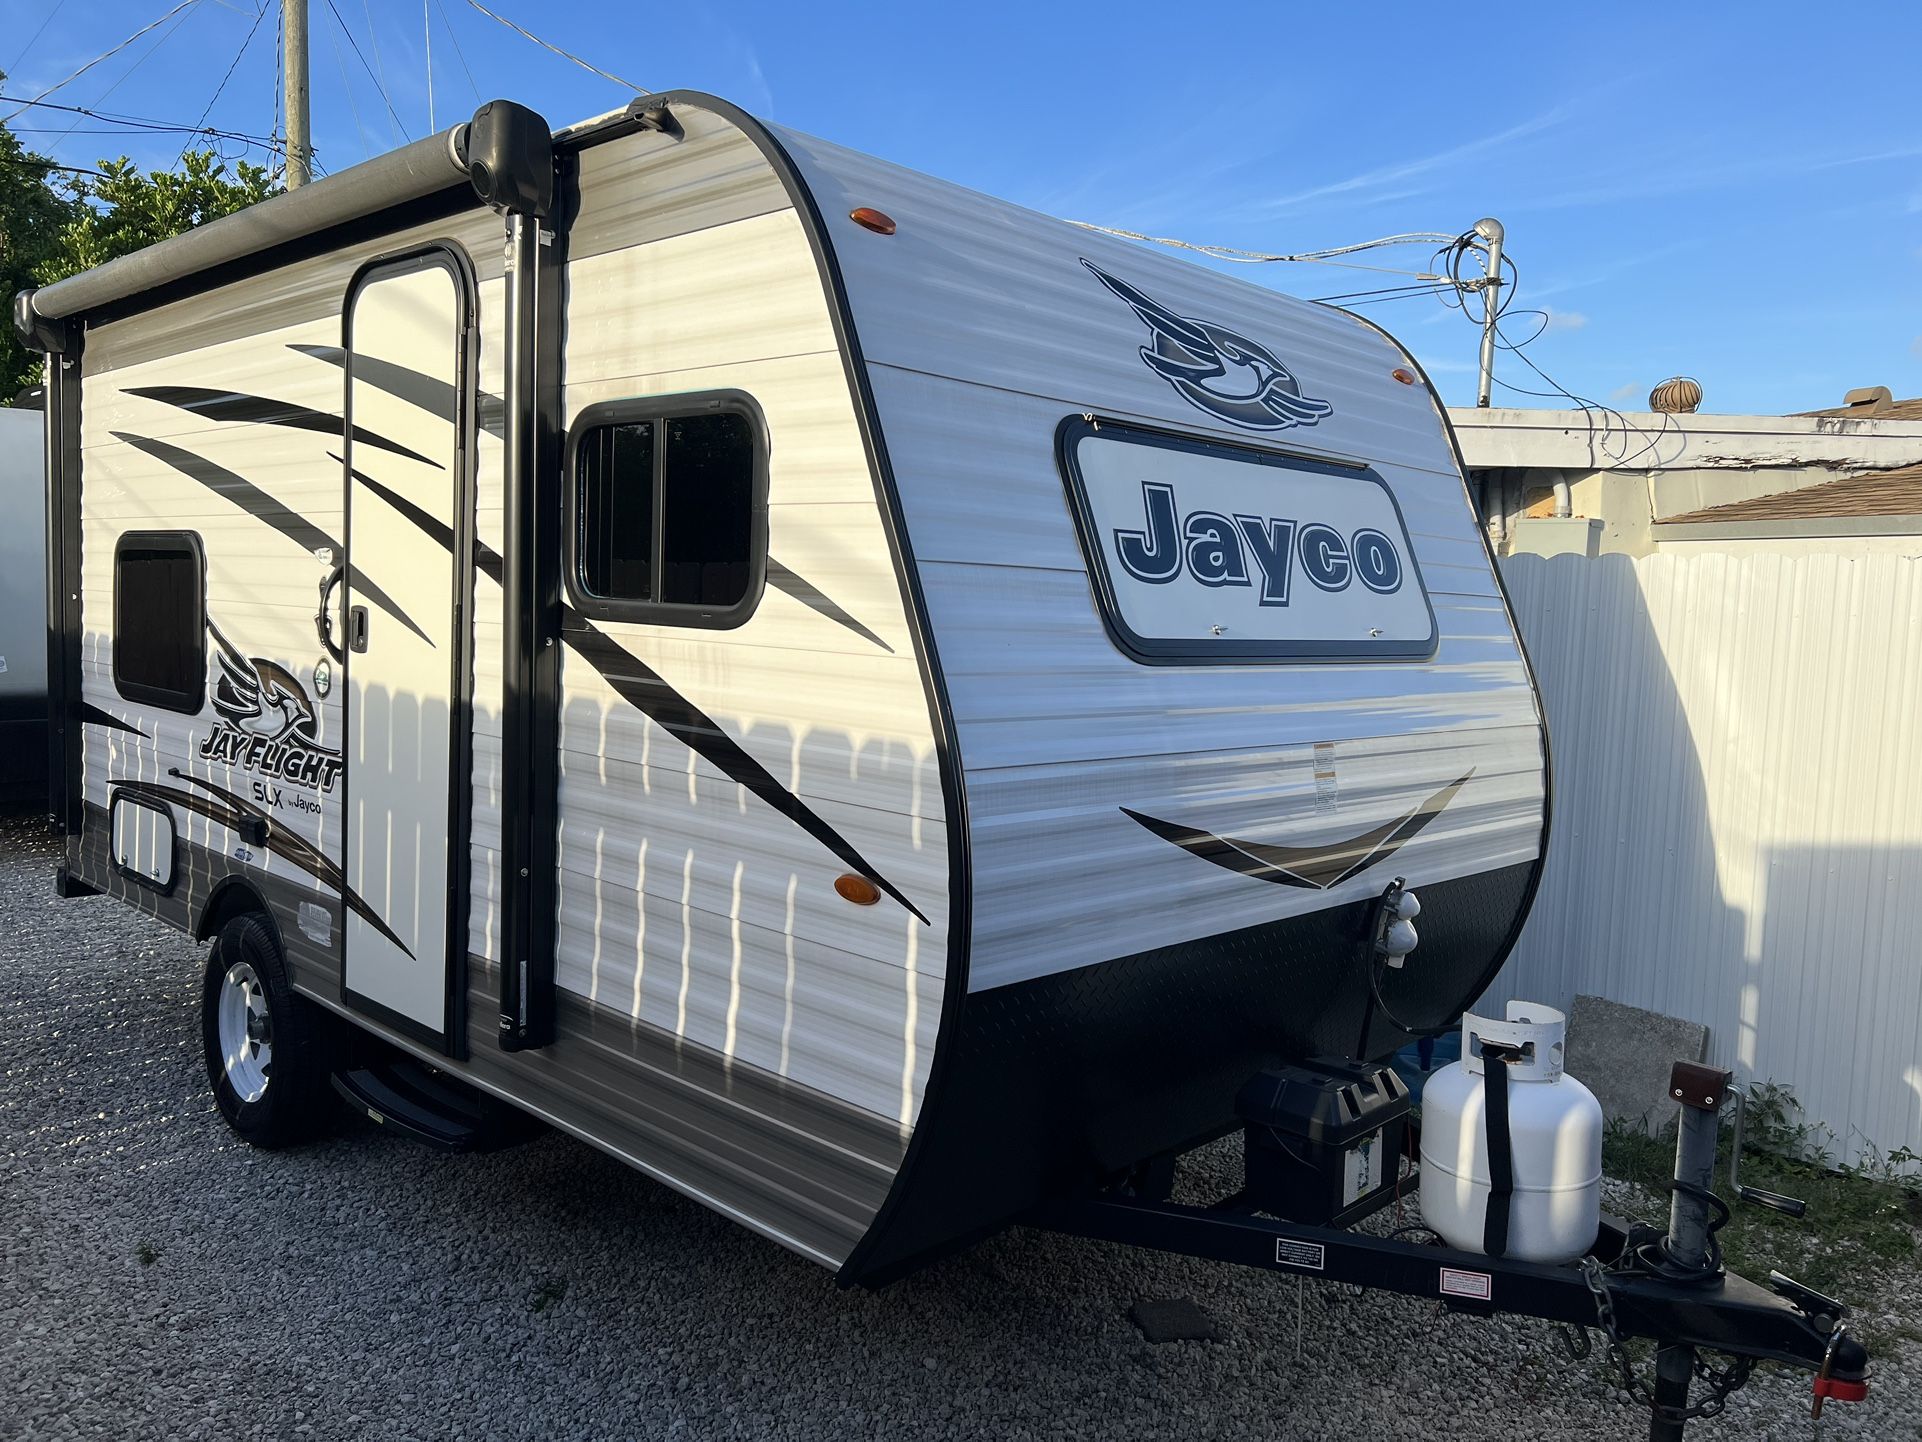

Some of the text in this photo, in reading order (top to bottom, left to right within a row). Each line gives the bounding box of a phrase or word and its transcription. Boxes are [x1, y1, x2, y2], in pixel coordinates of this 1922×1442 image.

[1113, 480, 1403, 607] Jayco
[200, 723, 342, 793] JAY FLIGHT
[253, 781, 283, 809] SLX
[293, 794, 321, 814] Jayco
